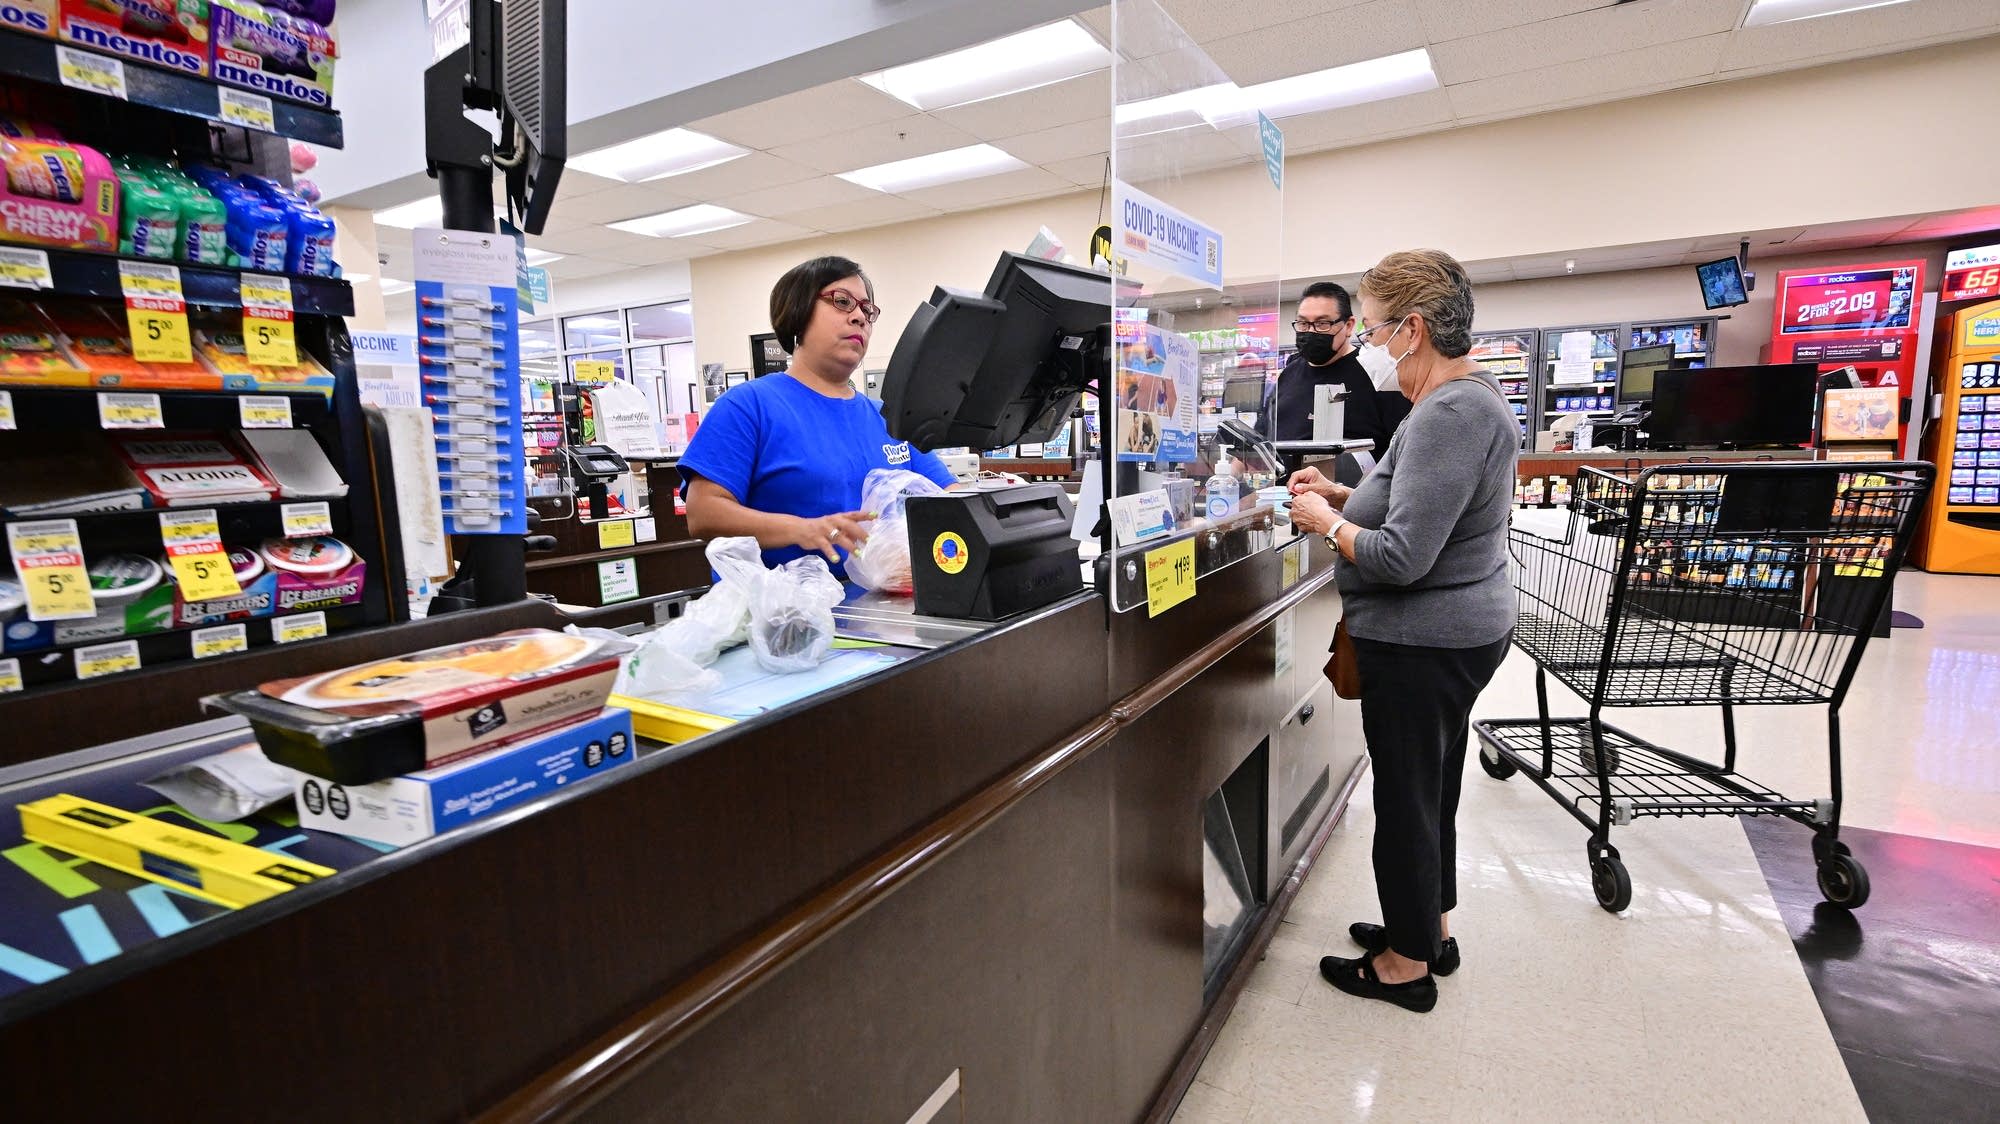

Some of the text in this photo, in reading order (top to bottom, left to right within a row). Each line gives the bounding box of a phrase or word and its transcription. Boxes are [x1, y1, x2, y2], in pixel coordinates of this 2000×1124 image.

[70, 23, 200, 71] mentos
[218, 63, 326, 104] mentos
[0, 201, 86, 226] CHEWY
[6, 216, 80, 240] FRESH
[1124, 198, 1165, 242] COVID-19
[1167, 217, 1199, 256] VACCINE
[252, 230, 269, 271] entos
[302, 236, 318, 276] entos
[1828, 275, 1856, 283] redbox
[1954, 288, 1988, 297] MILLION
[132, 299, 181, 312] Sale!
[249, 307, 289, 320] Sale!
[1797, 291, 1877, 322] 2 FOR $2.09
[353, 336, 398, 351] ACCINE
[1879, 370, 1899, 385] A
[161, 469, 248, 484] ALTOIDS
[173, 542, 219, 555] Sale!
[25, 555, 77, 568] Sale!
[181, 603, 205, 620] ICE
[207, 592, 271, 614] BREAKERS
[280, 582, 358, 608] ICE BREAKERS
